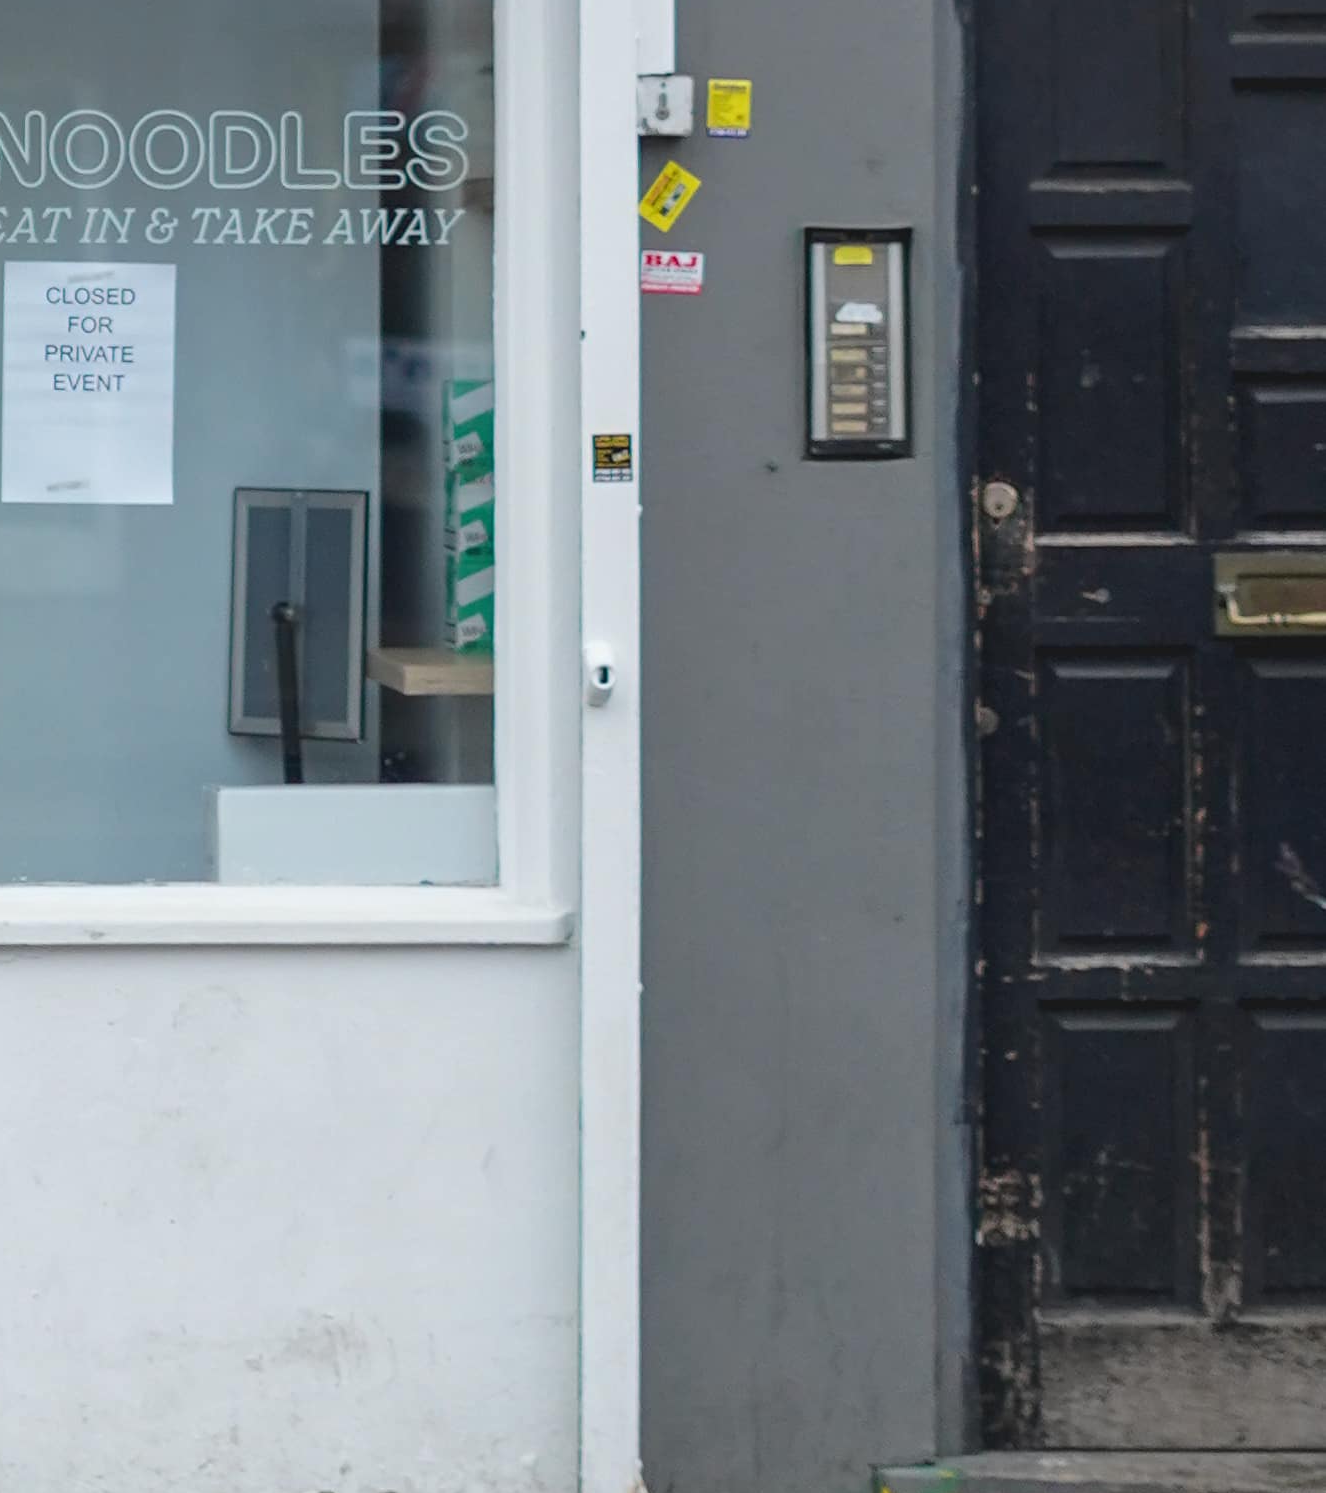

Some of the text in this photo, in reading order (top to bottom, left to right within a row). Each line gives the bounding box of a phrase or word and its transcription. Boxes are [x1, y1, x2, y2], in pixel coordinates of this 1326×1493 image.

[78, 207, 137, 244] IN
[145, 207, 179, 244] &
[191, 207, 315, 245] TAKE
[322, 208, 466, 246] AWAY
[645, 254, 697, 267] BAJ
[46, 286, 136, 306] CLOSED
[67, 315, 113, 334] FOR
[44, 344, 134, 364] PRIVATE
[53, 373, 125, 392] EVENT
